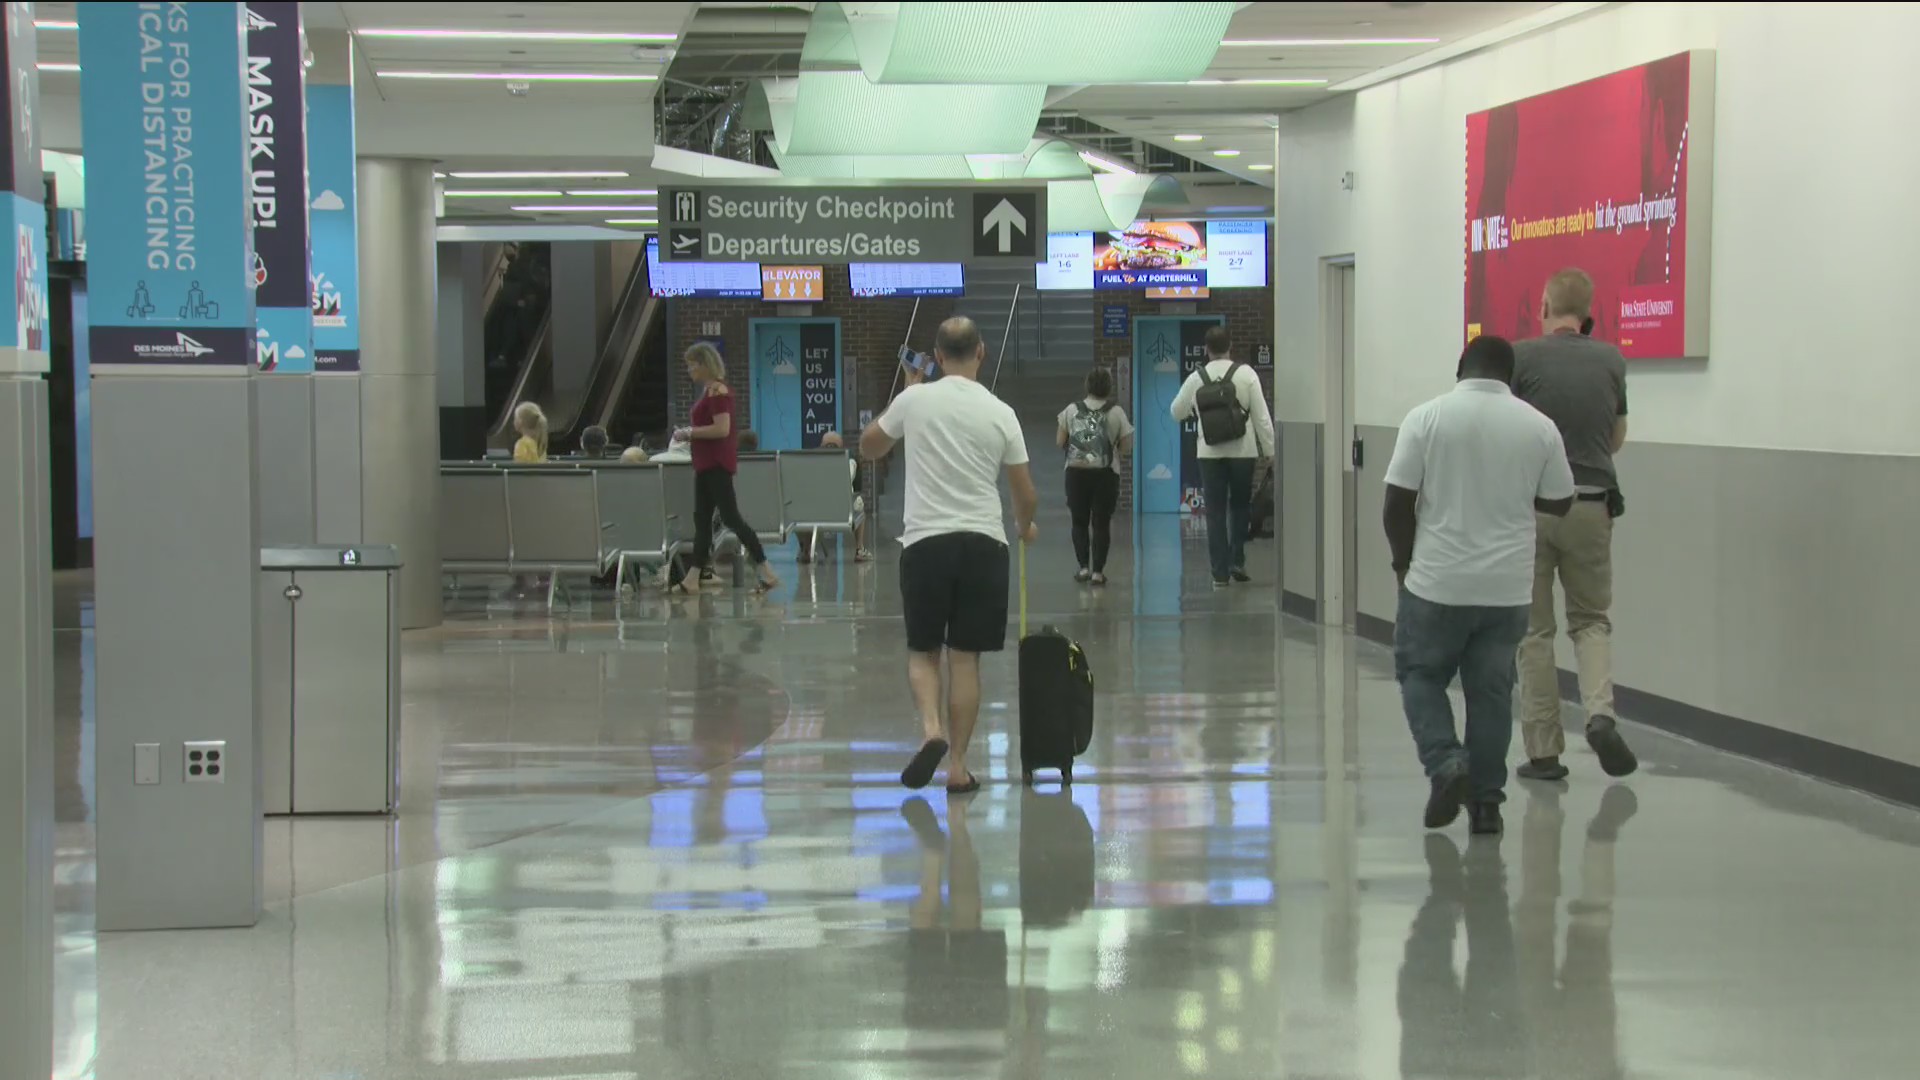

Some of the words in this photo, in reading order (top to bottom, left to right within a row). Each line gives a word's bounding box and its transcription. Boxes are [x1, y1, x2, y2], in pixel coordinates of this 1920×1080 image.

[168, 42, 190, 98] FOR
[247, 56, 275, 160] MASK
[142, 82, 170, 269] DISTANCING
[171, 107, 196, 271] PRACTICING
[252, 170, 277, 228] UP!
[707, 195, 808, 224] Security
[816, 196, 955, 224] Checkpoint
[1511, 217, 1522, 242] Our
[1523, 216, 1555, 239] innovators
[1556, 215, 1566, 235] are
[1566, 206, 1586, 237] ready
[1586, 207, 1594, 231] to
[1595, 200, 1604, 228] hit
[1605, 198, 1617, 228] the
[1616, 192, 1643, 235] ground
[1643, 191, 1677, 231] sprinting.
[707, 232, 921, 260] Departures/Gates
[1229, 257, 1244, 266] 2-7
[762, 270, 821, 281] ELEVATOR
[1102, 275, 1122, 283] FUEL
[1137, 274, 1147, 283] AT
[805, 348, 829, 359] LET
[805, 363, 823, 374] US
[805, 378, 836, 390] GIVE
[805, 393, 834, 405] YOU
[805, 409, 816, 420] A
